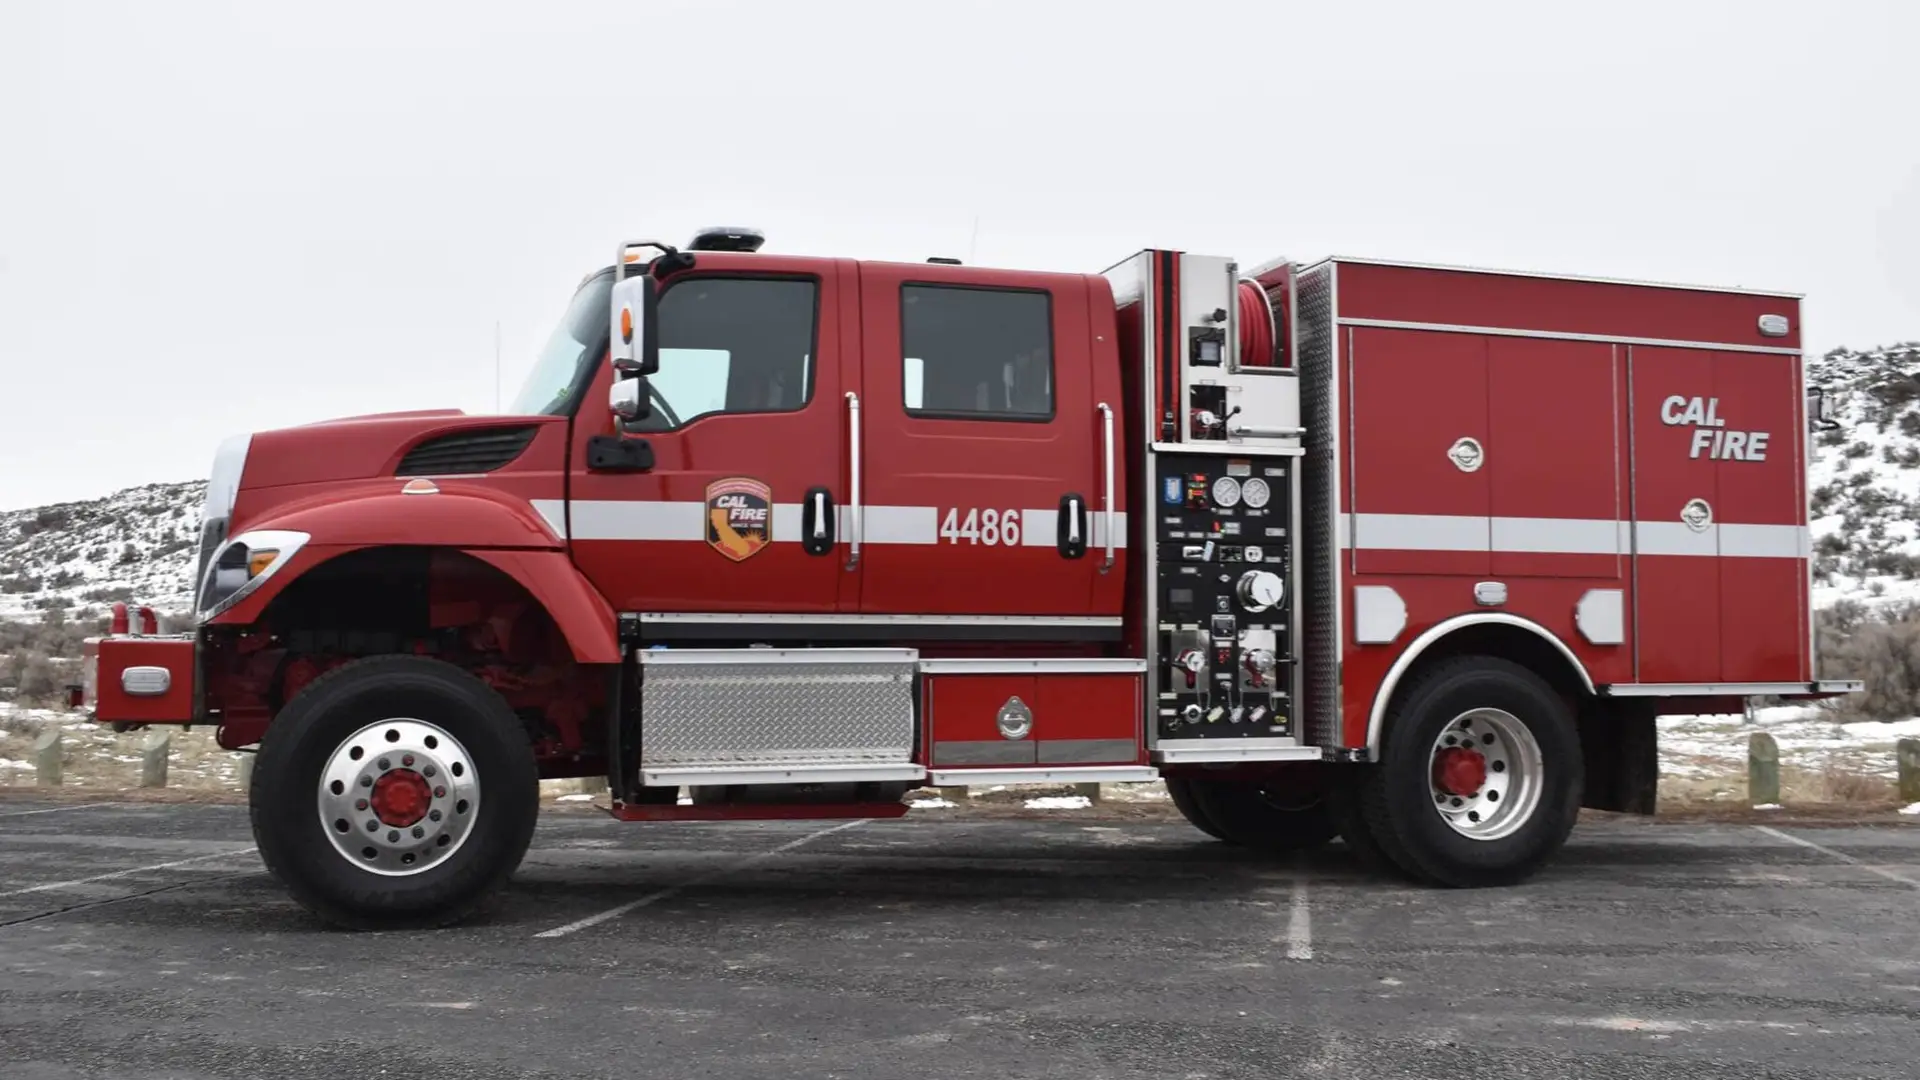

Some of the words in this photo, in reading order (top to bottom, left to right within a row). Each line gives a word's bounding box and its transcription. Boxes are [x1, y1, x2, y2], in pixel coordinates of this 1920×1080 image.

[1661, 395, 1725, 427] CAL
[1689, 429, 1770, 461] FIRE
[716, 495, 748, 508] CAL
[730, 508, 768, 520] FIRE
[940, 507, 1020, 546] 4486
